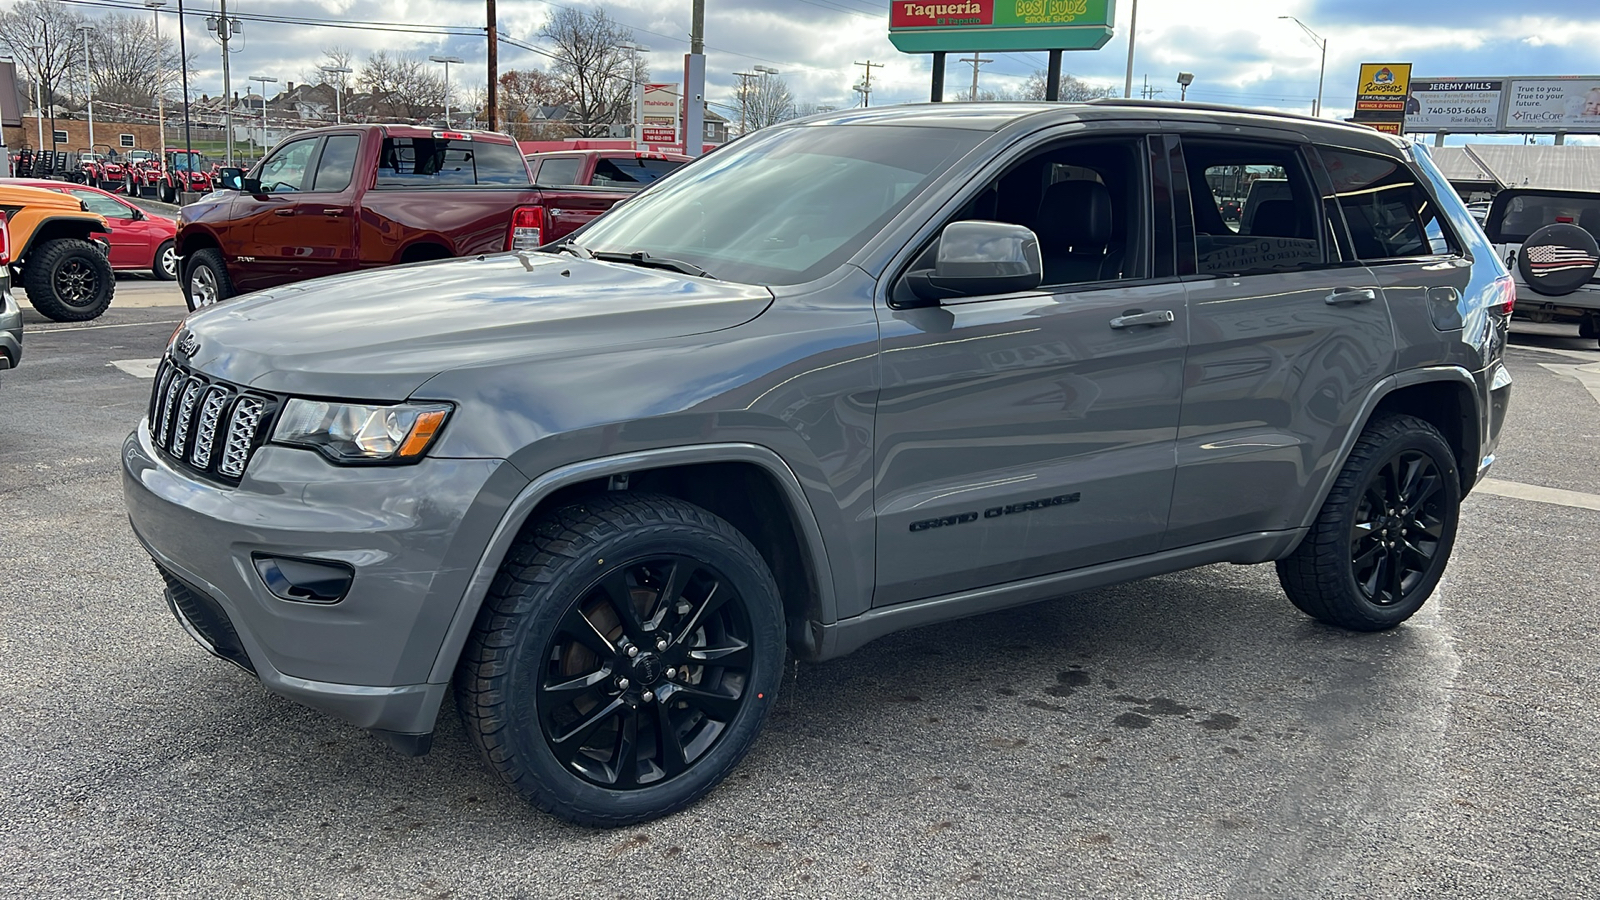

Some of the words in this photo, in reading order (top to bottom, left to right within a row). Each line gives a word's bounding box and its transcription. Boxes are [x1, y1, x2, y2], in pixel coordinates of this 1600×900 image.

[1025, 15, 1051, 24] SMOKE
[1053, 15, 1075, 23] SHOP
[1364, 82, 1402, 93] Roosters
[1464, 116, 1482, 124] Realty
[1521, 111, 1564, 120] TrueCore
[909, 511, 979, 532] GRAND
[984, 492, 1081, 519] CHEROKEE
